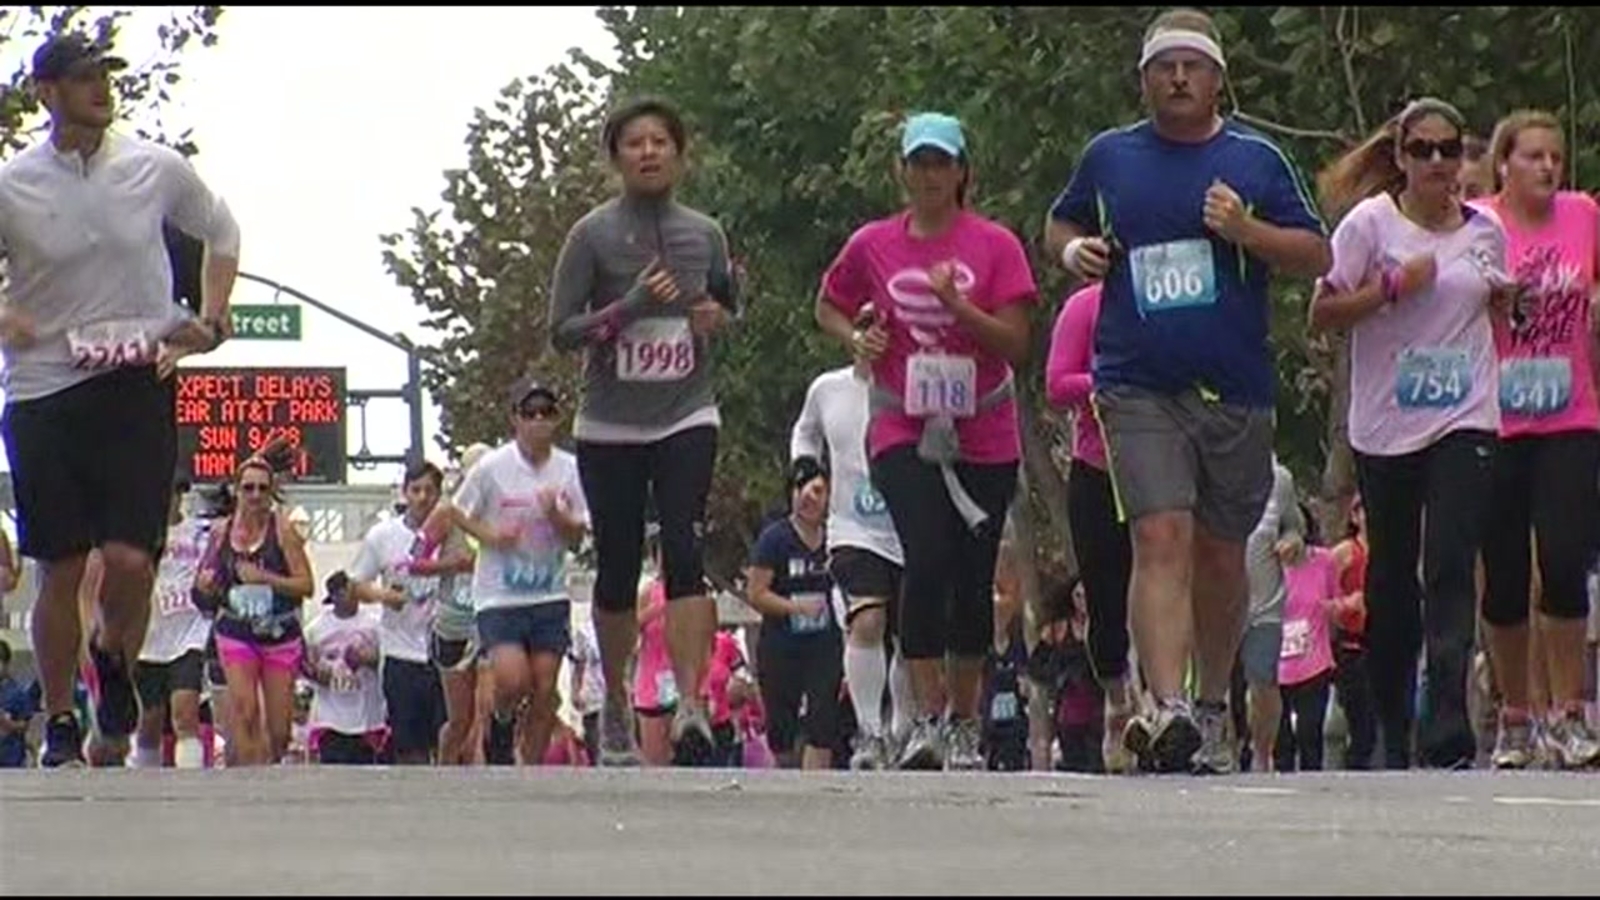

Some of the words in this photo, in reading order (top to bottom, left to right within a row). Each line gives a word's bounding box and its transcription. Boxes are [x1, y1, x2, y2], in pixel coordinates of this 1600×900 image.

[1145, 266, 1203, 304] 606
[620, 341, 691, 373] 1998
[255, 375, 332, 398] DELAYS
[917, 379, 966, 410] 118
[1409, 369, 1461, 401] 754
[221, 400, 278, 422] AT&T
[289, 400, 338, 422] PARK
[200, 426, 237, 449] SUN
[194, 452, 235, 475] 11AM
